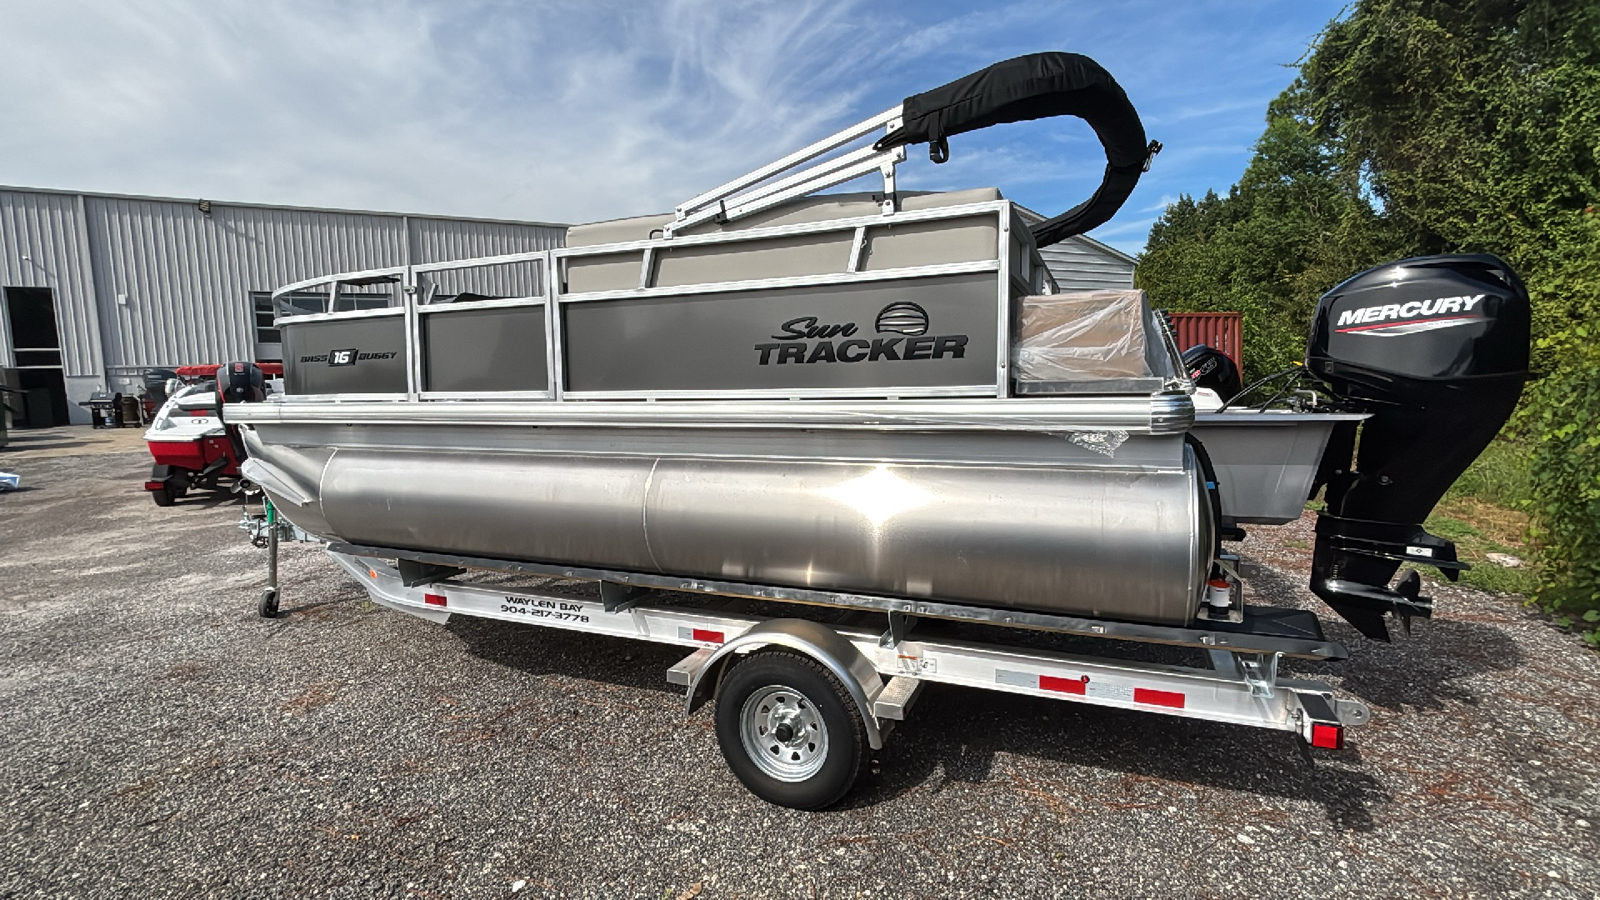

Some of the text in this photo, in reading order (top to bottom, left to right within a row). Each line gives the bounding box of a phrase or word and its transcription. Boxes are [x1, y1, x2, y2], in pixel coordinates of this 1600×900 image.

[1337, 294, 1486, 327] MERCURY
[771, 316, 859, 341] Sun
[333, 350, 351, 364] 16
[358, 351, 397, 360] BUGGY
[754, 334, 969, 366] TRACKER
[500, 604, 590, 623] 904-217-3778
[505, 596, 583, 613] WAYLEN BAY
